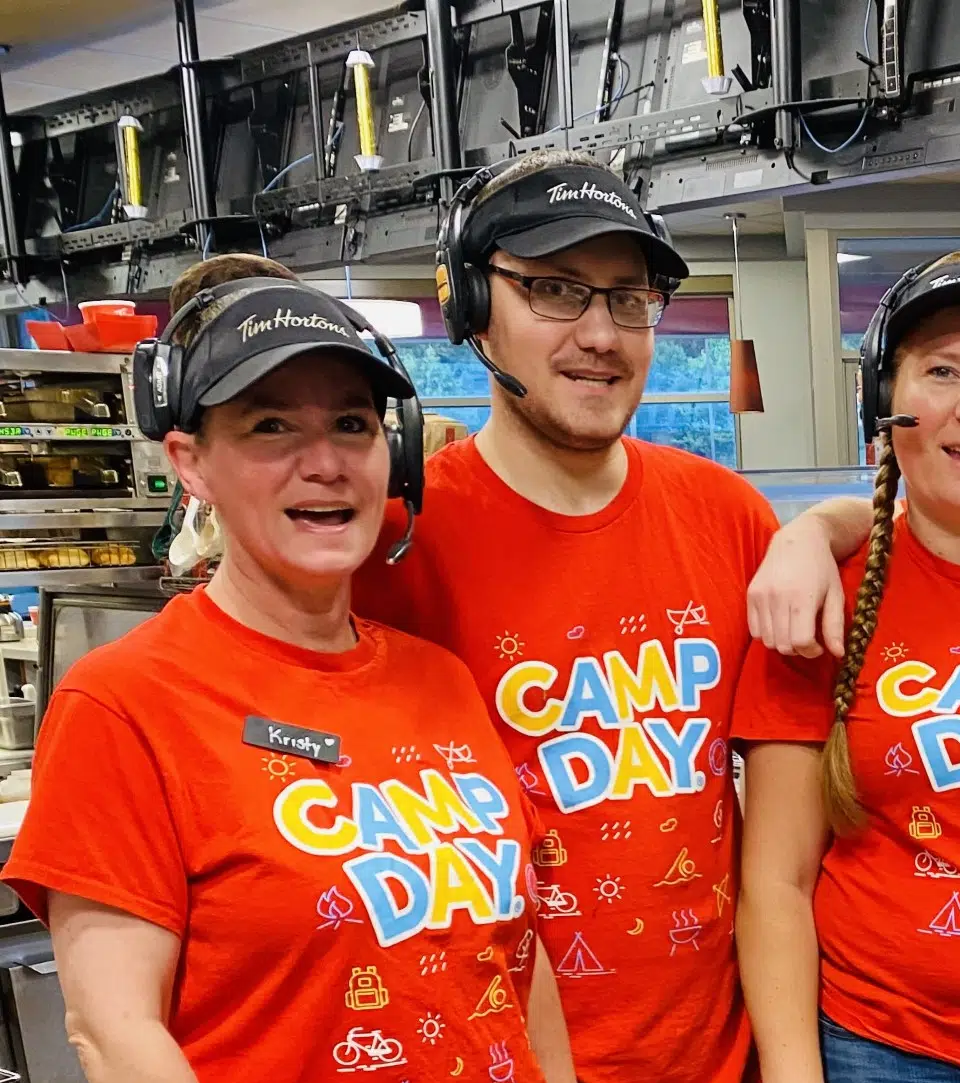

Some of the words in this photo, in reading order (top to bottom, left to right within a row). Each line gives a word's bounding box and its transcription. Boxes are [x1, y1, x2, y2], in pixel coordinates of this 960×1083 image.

[546, 182, 579, 204] Tim
[579, 181, 638, 220] Hortons
[236, 313, 273, 343] Tim
[272, 308, 351, 338] Hortons
[495, 637, 721, 737] CAMP
[268, 725, 322, 758] Kristy
[272, 768, 509, 856] CAMP
